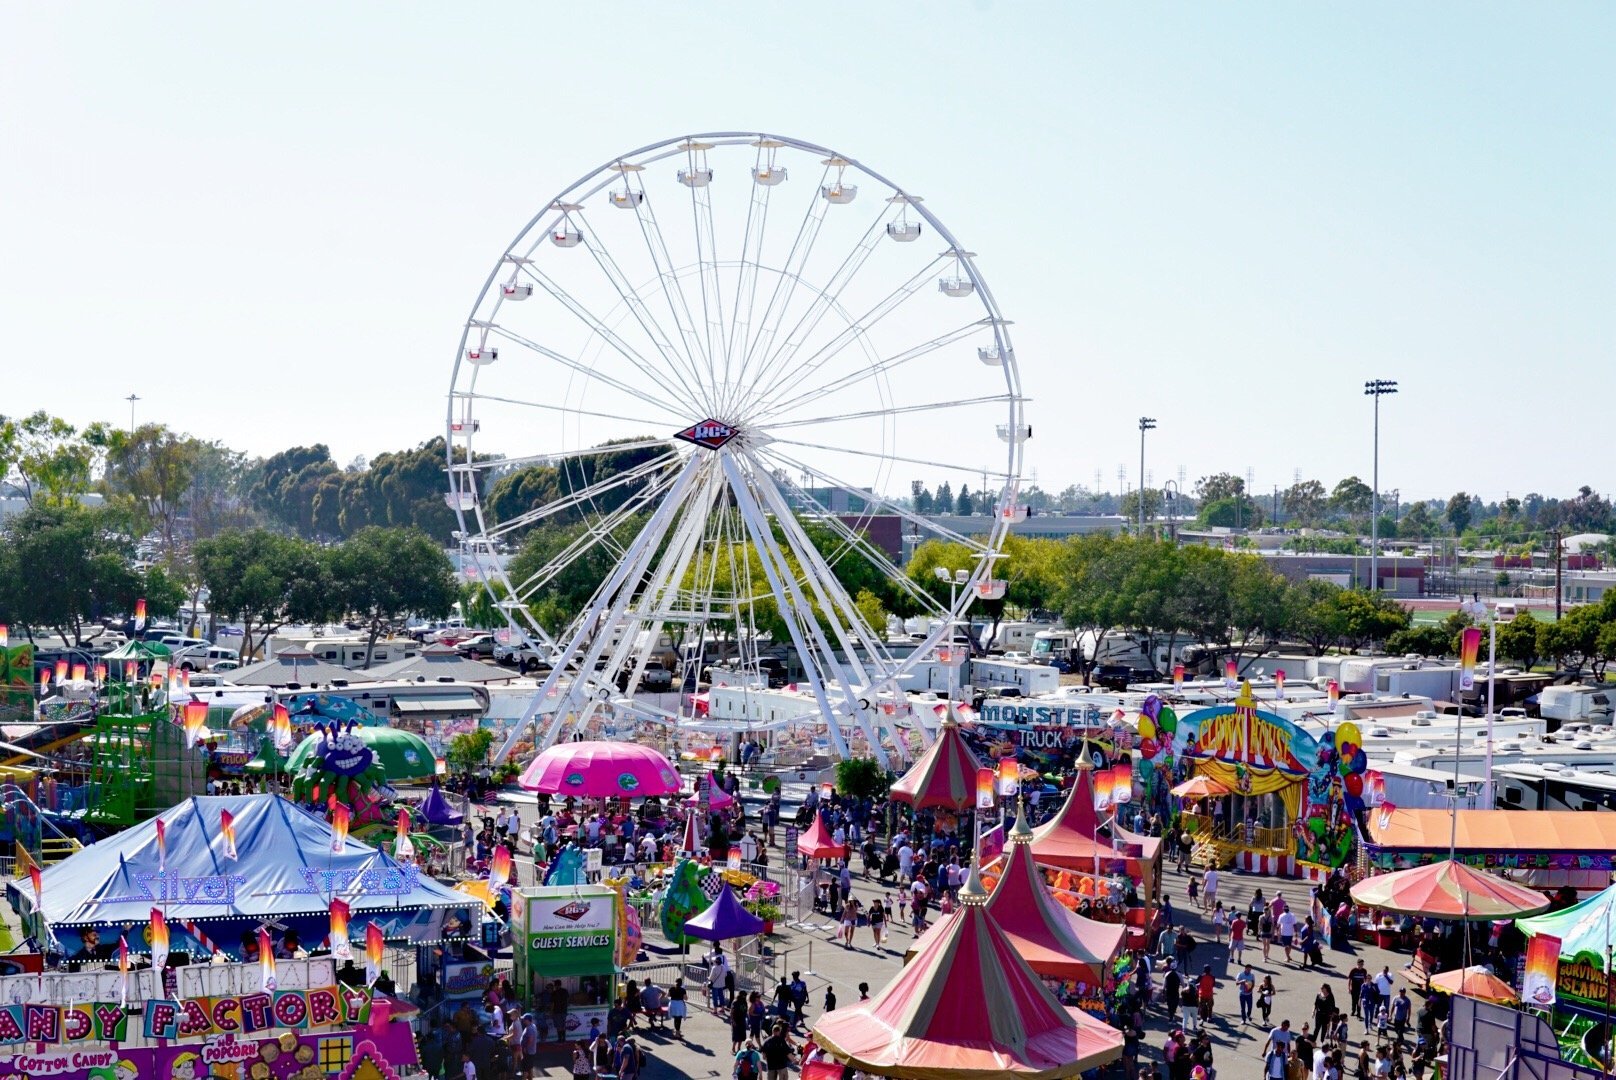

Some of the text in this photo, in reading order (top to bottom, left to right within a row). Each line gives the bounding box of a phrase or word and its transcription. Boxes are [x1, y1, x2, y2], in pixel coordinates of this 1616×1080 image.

[694, 426, 730, 439] RCS
[980, 705, 1101, 726] MONSTER
[1019, 729, 1064, 749] TRUCK
[1199, 713, 1293, 765] CLOWN HOUSE
[532, 934, 609, 949] GUEST SERVICES
[1560, 963, 1609, 986] SURVIVAL
[1558, 976, 1609, 999] ISLAND
[151, 987, 372, 1037] FACTORY
[206, 1044, 256, 1060] POPCORN
[18, 1053, 113, 1072] COTTON CANDY
